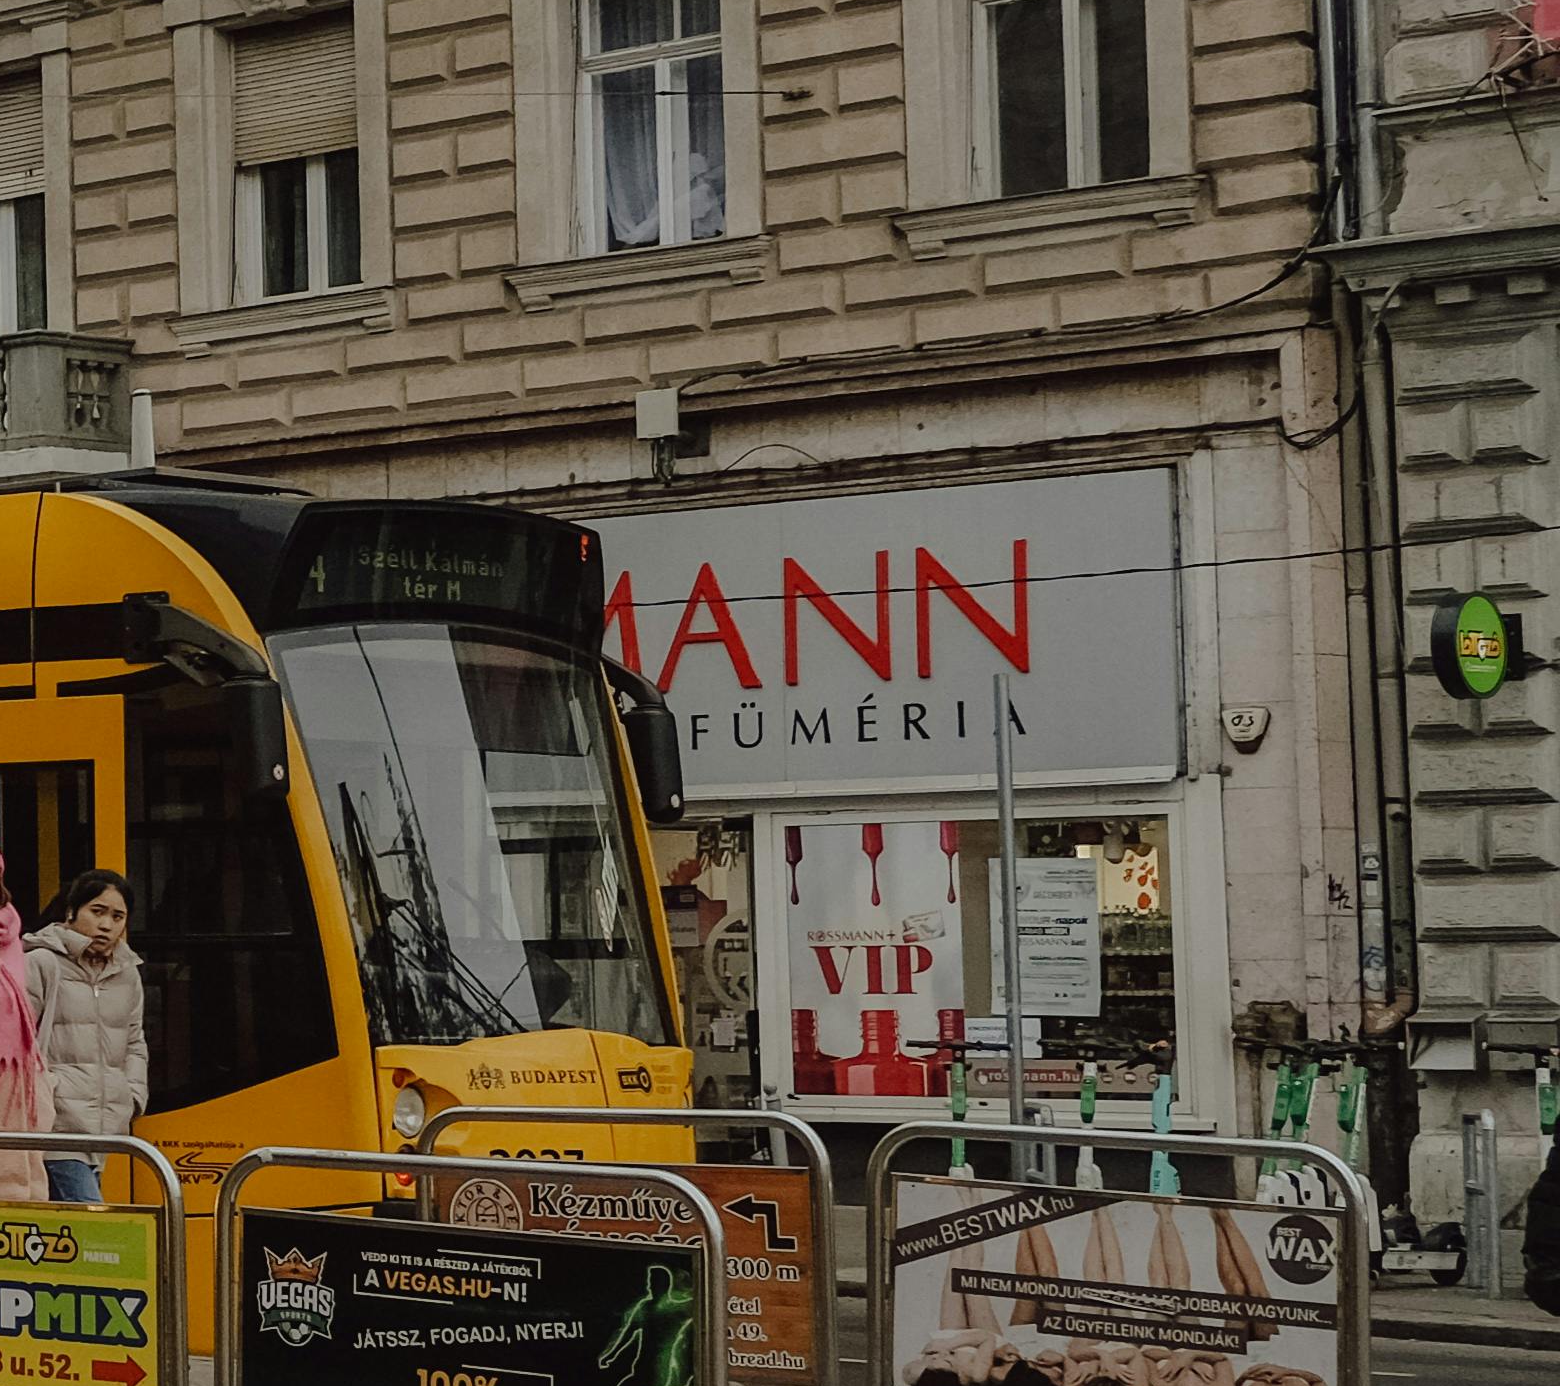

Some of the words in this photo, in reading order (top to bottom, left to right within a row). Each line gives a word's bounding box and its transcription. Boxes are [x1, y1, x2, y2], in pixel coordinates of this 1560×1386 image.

[308, 554, 327, 594] 4
[402, 578, 439, 601] tér
[446, 581, 462, 602] M
[809, 945, 934, 995] VIP
[510, 1070, 598, 1085] BUDAPEST
[896, 1195, 1075, 1258] www.BESTWAX.hu
[1276, 1226, 1302, 1238] BEST
[360, 1251, 388, 1263] VEDD
[389, 1254, 400, 1264] KI
[401, 1255, 412, 1266] TE
[413, 1256, 423, 1267] IS
[424, 1257, 434, 1268] A
[433, 1256, 471, 1271] RÉSZED
[471, 1262, 480, 1272] A
[480, 1261, 534, 1278] JÁTÉKBÓL
[1264, 1234, 1337, 1266] WAX
[726, 1256, 772, 1281] 300
[776, 1265, 800, 1282] m
[363, 1268, 381, 1288] A
[382, 1268, 528, 1303] VEGAS.HU-N!
[960, 1275, 978, 1289] MI
[980, 1277, 1012, 1293] NEM
[260, 1281, 332, 1317] VEGAS
[353, 1326, 426, 1350] JÁTSSZ,
[430, 1324, 512, 1347] FOGADJ,
[516, 1321, 584, 1342] NYERJ!
[736, 1322, 768, 1343] 49.
[1042, 1315, 1063, 1331] AZ
[1064, 1315, 1156, 1340] ÜGYFELEINK
[1158, 1328, 1240, 1349] MONDJÁK!
[10, 1355, 34, 1376] u.
[39, 1352, 80, 1381] 52.
